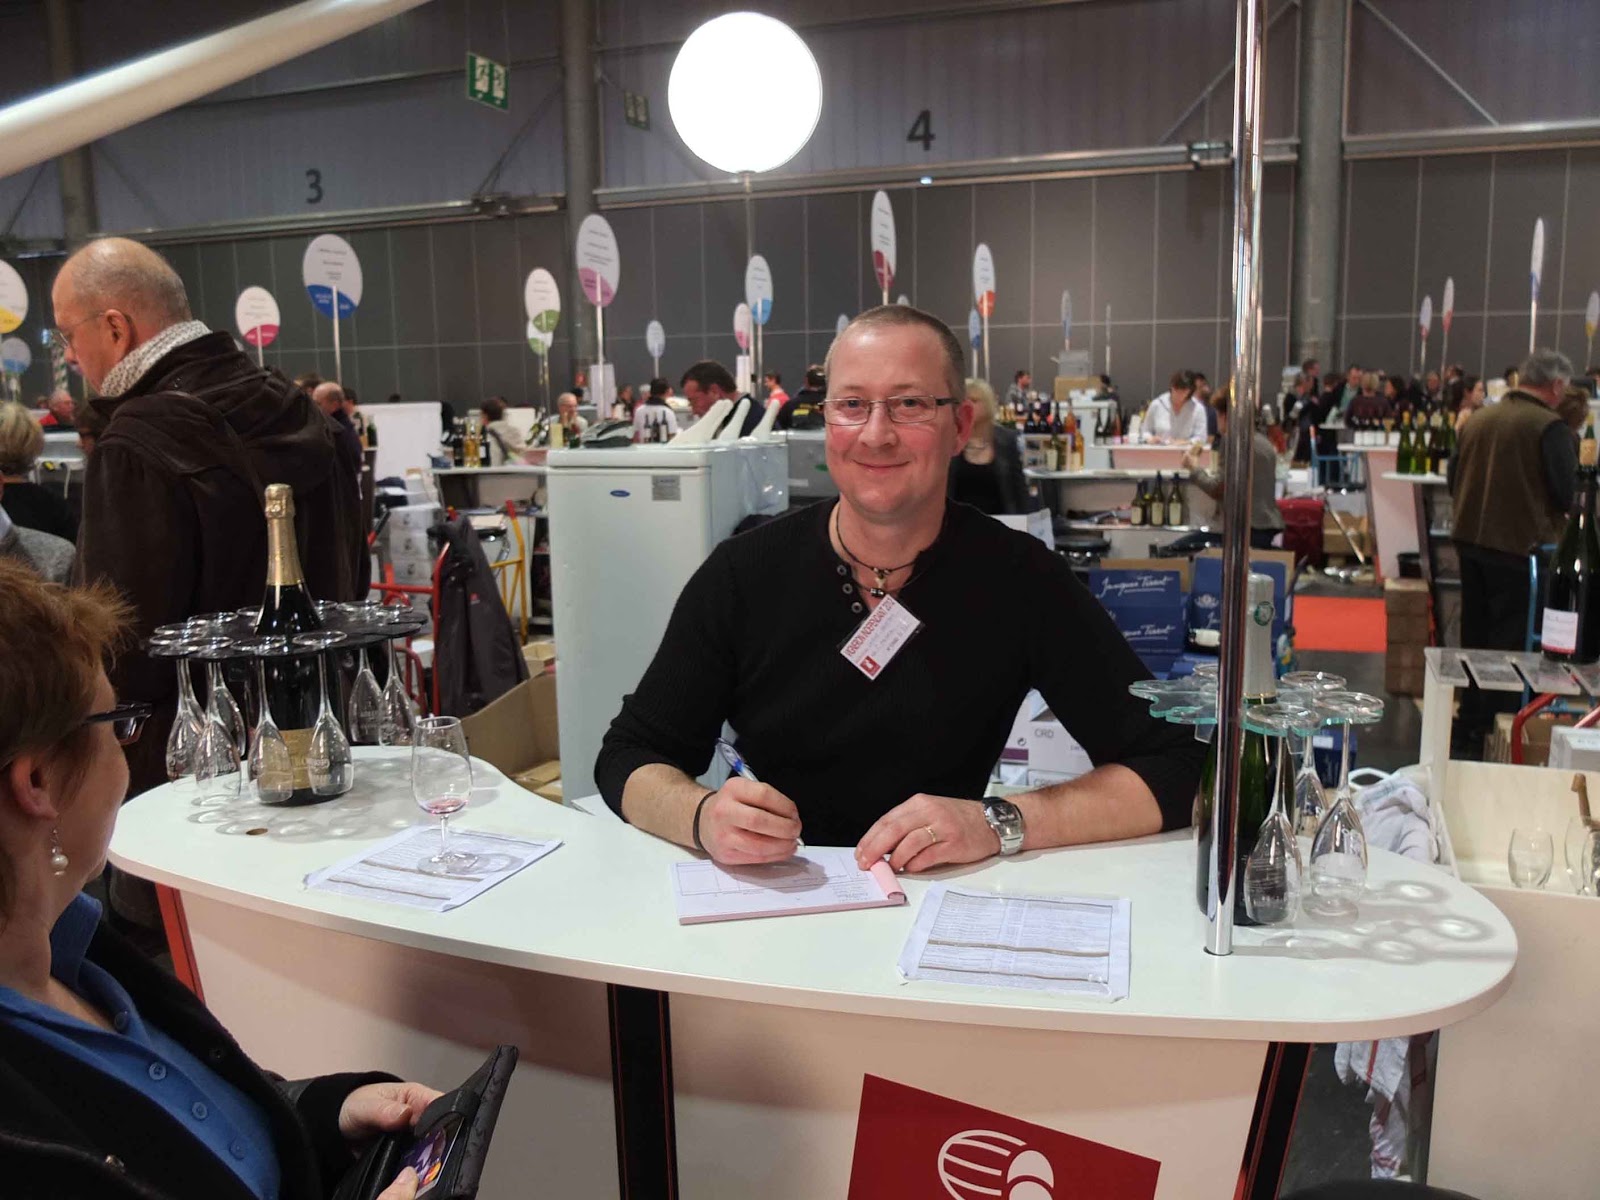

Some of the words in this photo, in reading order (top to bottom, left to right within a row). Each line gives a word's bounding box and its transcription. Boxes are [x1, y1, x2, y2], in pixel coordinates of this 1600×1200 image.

[906, 110, 936, 151] 4
[305, 169, 323, 204] 3
[1034, 728, 1054, 738] CRD
